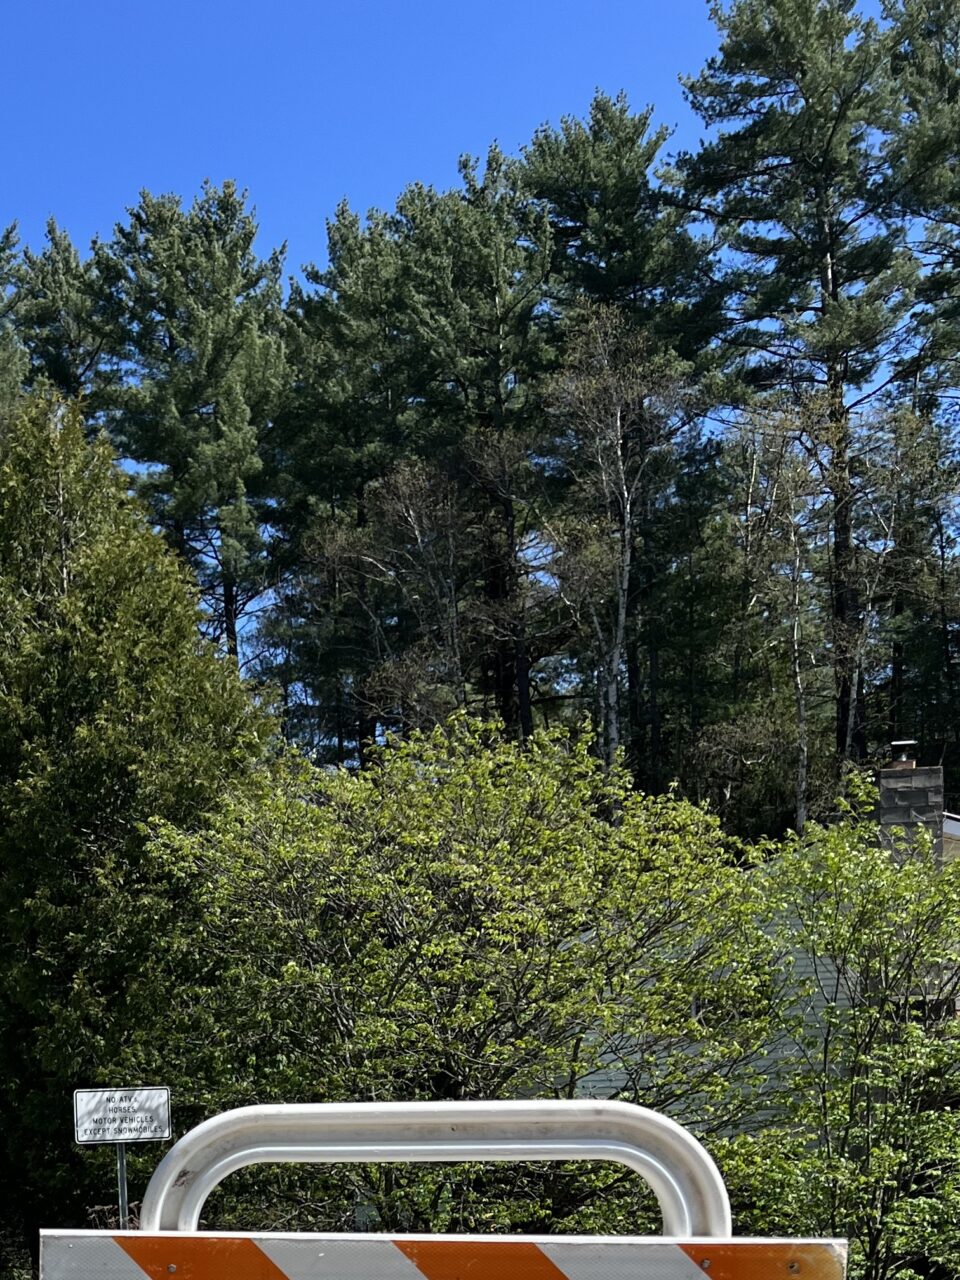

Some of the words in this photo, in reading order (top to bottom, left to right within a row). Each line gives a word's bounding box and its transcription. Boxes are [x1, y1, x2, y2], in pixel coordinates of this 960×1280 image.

[93, 1117, 117, 1125] MOTOR
[119, 1115, 154, 1124] VEHICLES
[84, 1127, 110, 1136] EXCEPT
